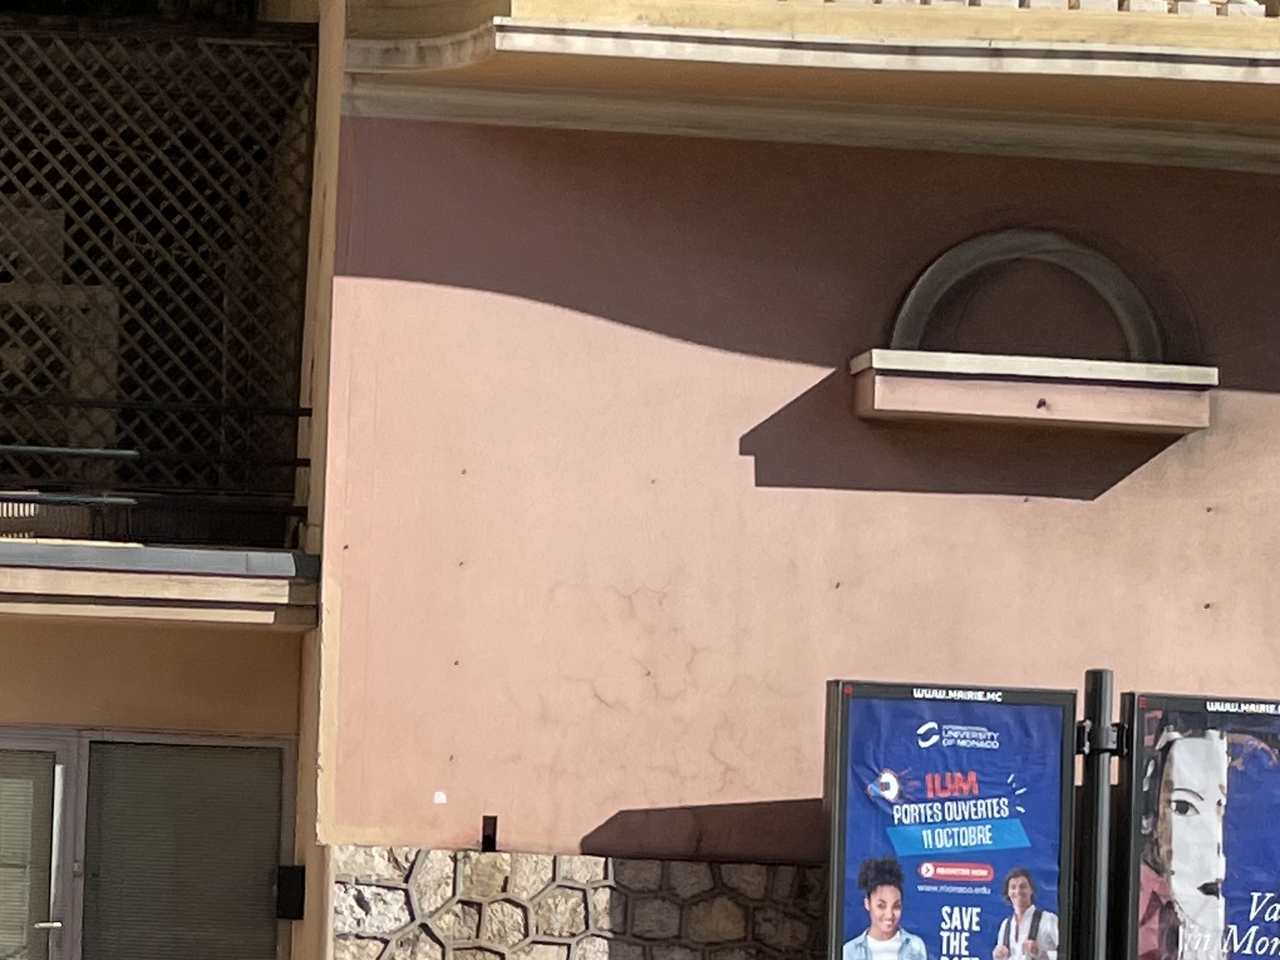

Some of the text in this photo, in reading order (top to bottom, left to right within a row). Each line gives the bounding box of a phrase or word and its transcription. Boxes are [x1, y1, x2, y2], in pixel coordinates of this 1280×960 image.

[956, 739, 1000, 749] MONACO
[925, 770, 979, 798] IUM
[892, 797, 1009, 825] PORTES OUVERTES
[922, 824, 993, 849] 11 OCTOBRE
[940, 906, 981, 931] SAVE
[939, 931, 969, 955] THE
